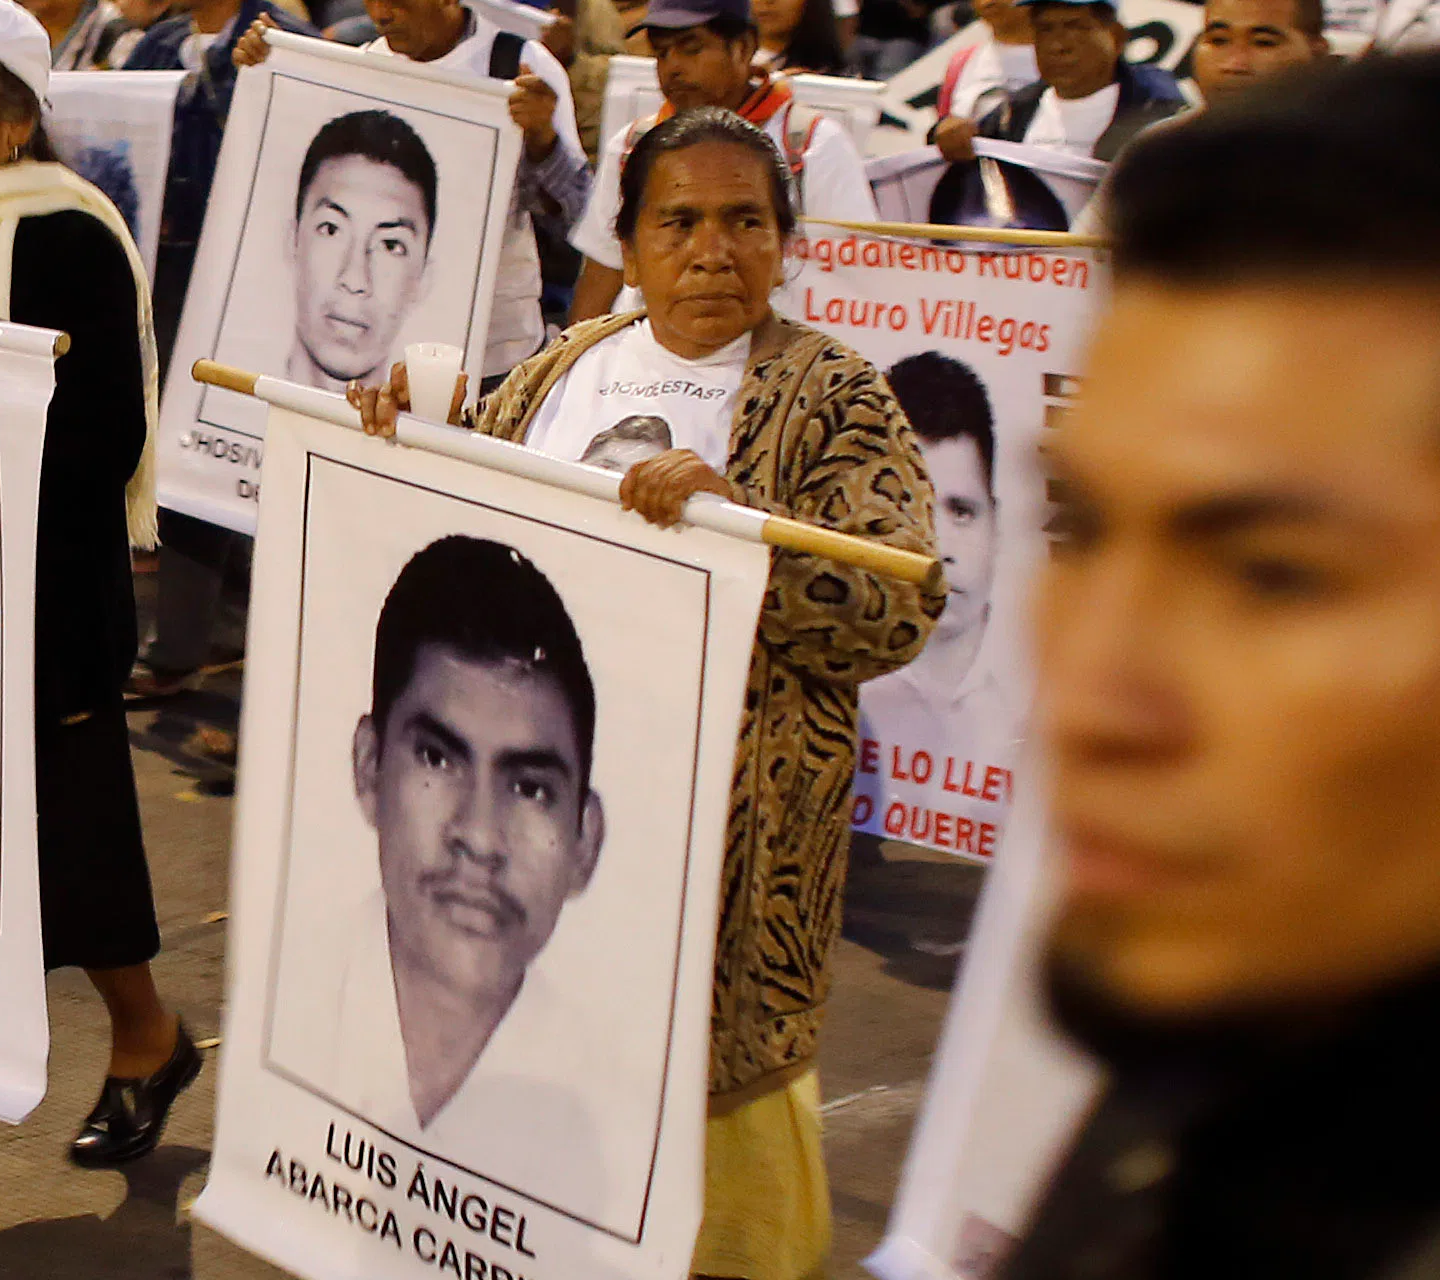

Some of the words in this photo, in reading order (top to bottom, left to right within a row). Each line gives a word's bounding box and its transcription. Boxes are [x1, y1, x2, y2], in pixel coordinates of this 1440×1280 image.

[786, 234, 967, 274] agdaleno
[804, 287, 908, 332] Lauro
[919, 298, 1052, 357] Villegas
[891, 745, 934, 786] LO
[264, 1149, 403, 1249] ABARCA
[325, 1121, 398, 1189] LUIS
[407, 1161, 537, 1260] ÁNGEL
